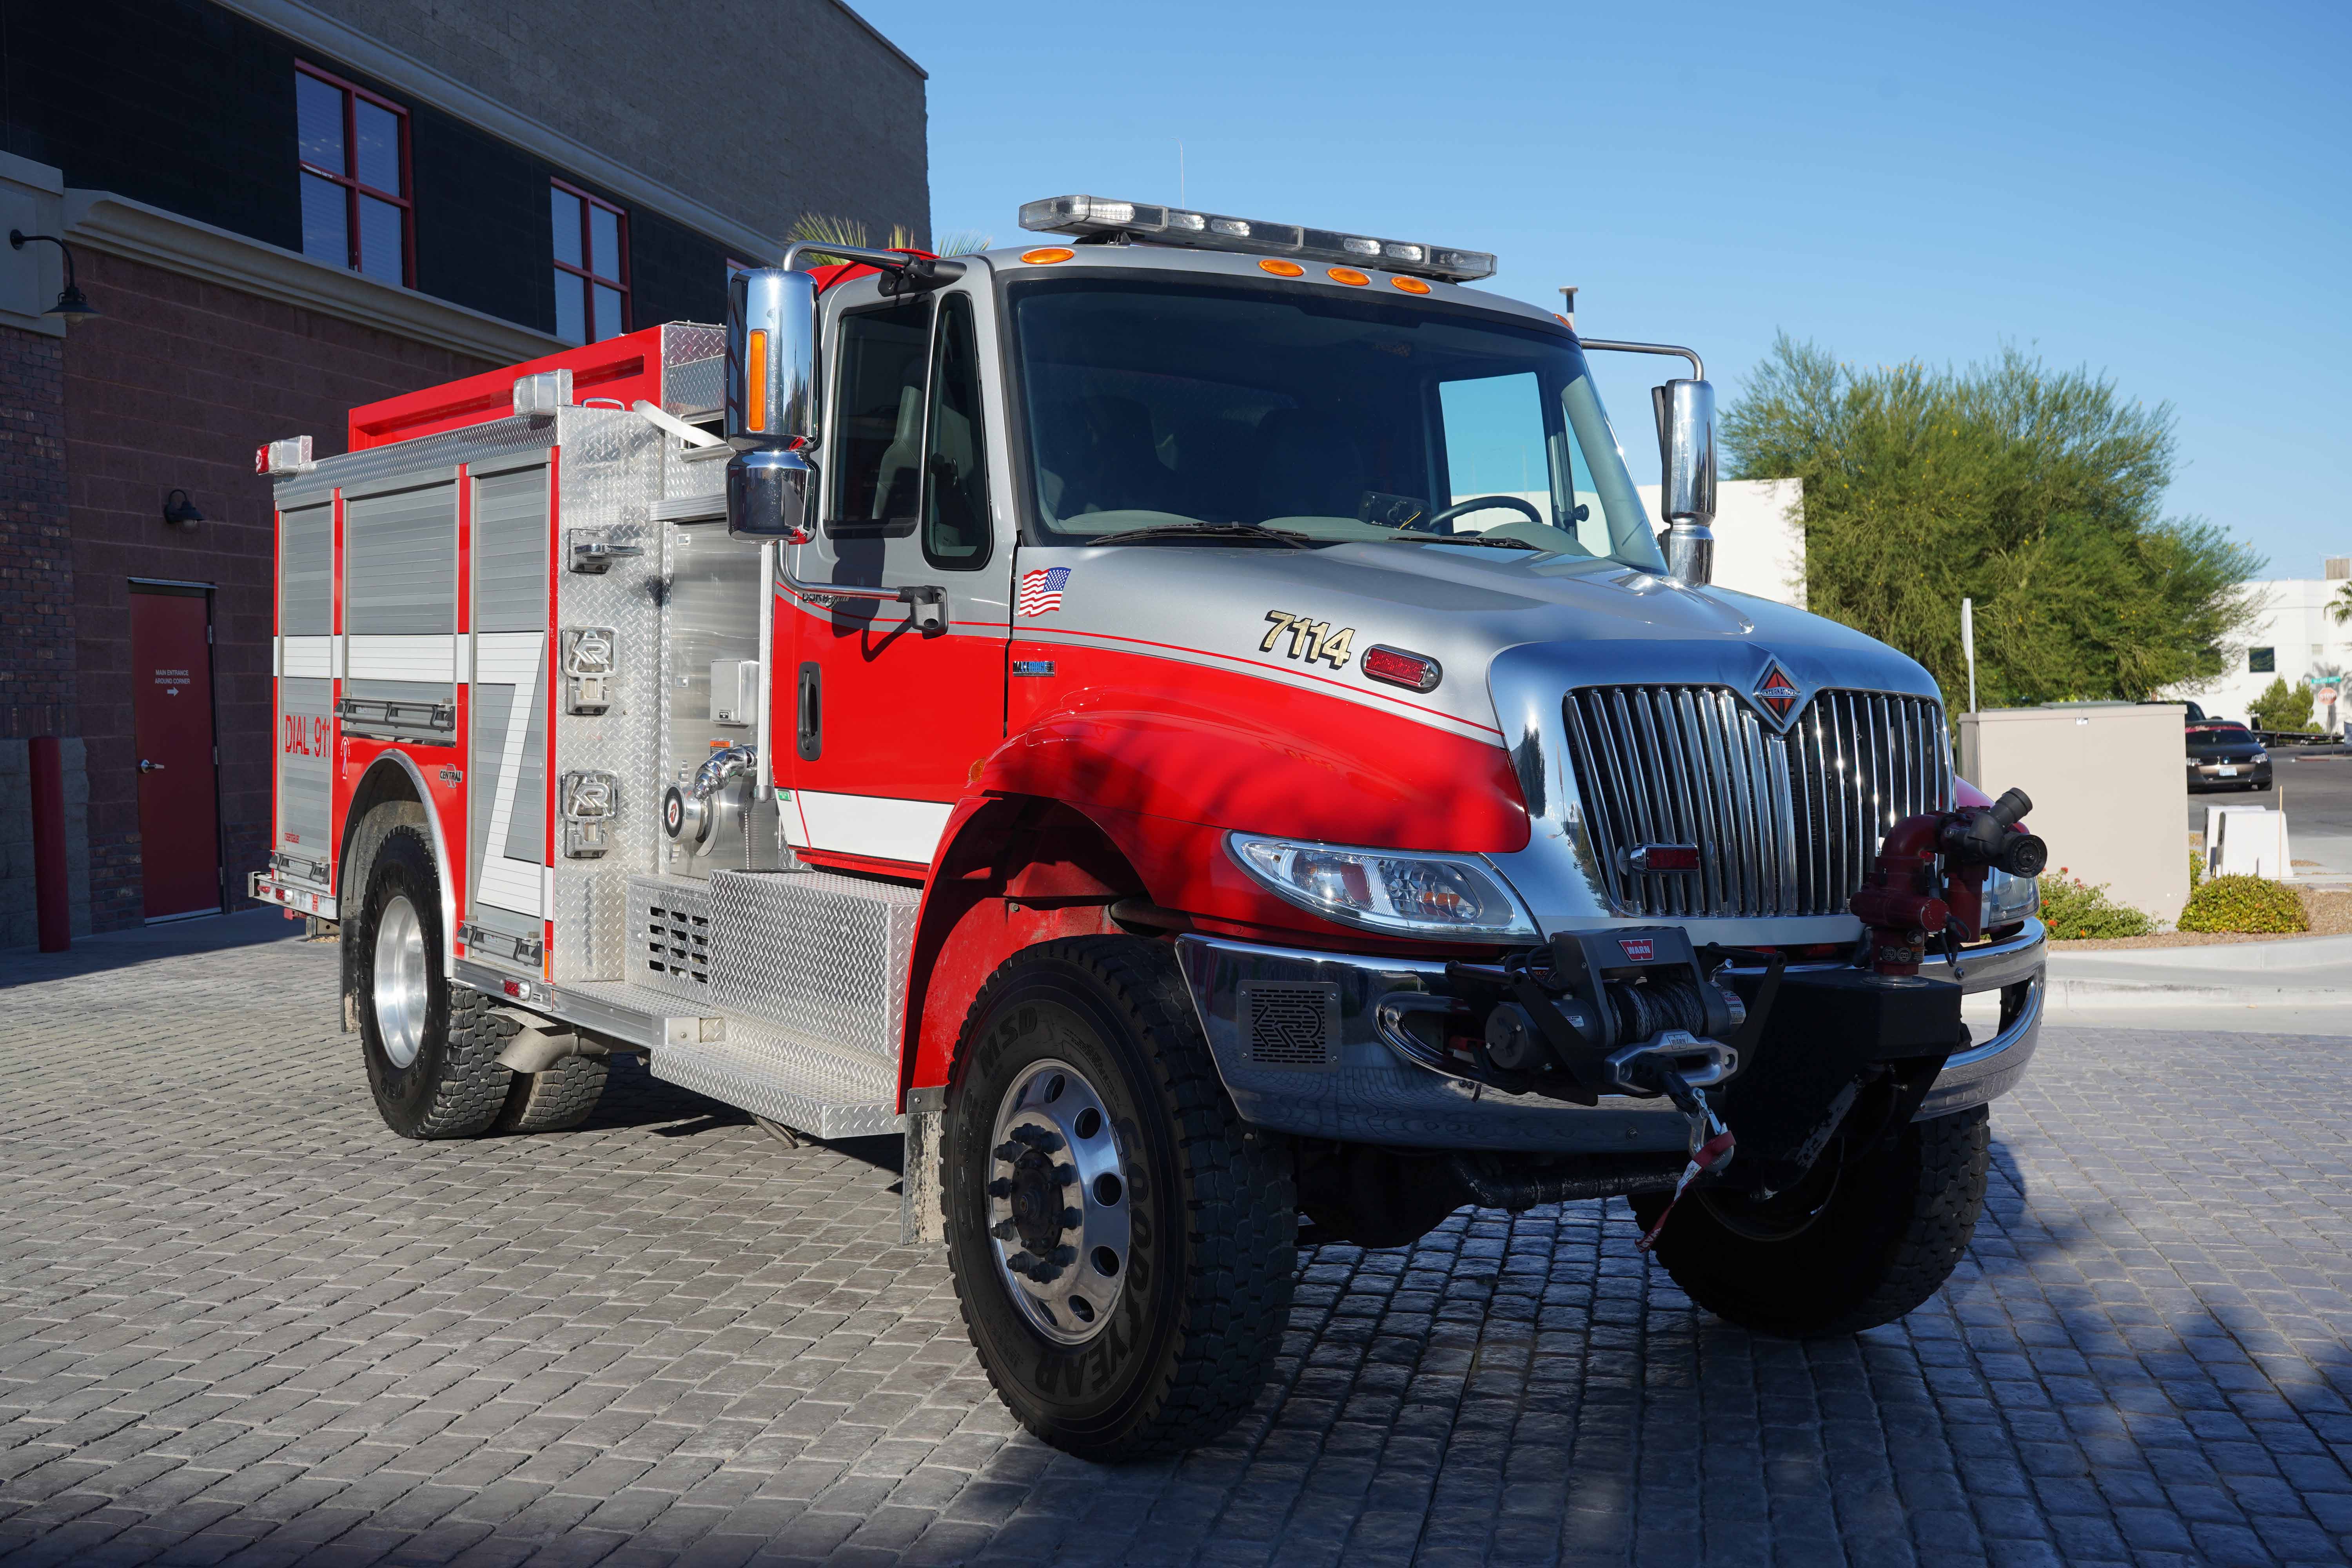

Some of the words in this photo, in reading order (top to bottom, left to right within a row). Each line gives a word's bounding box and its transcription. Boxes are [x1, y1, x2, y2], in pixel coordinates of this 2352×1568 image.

[1259, 610, 1356, 670] 7114
[285, 715, 309, 755] DIAL
[440, 771, 461, 782] CENTRAL
[1626, 946, 1651, 954] WARN
[979, 1007, 1037, 1079] MSD
[1035, 1117, 1152, 1397] GOODYEAR
